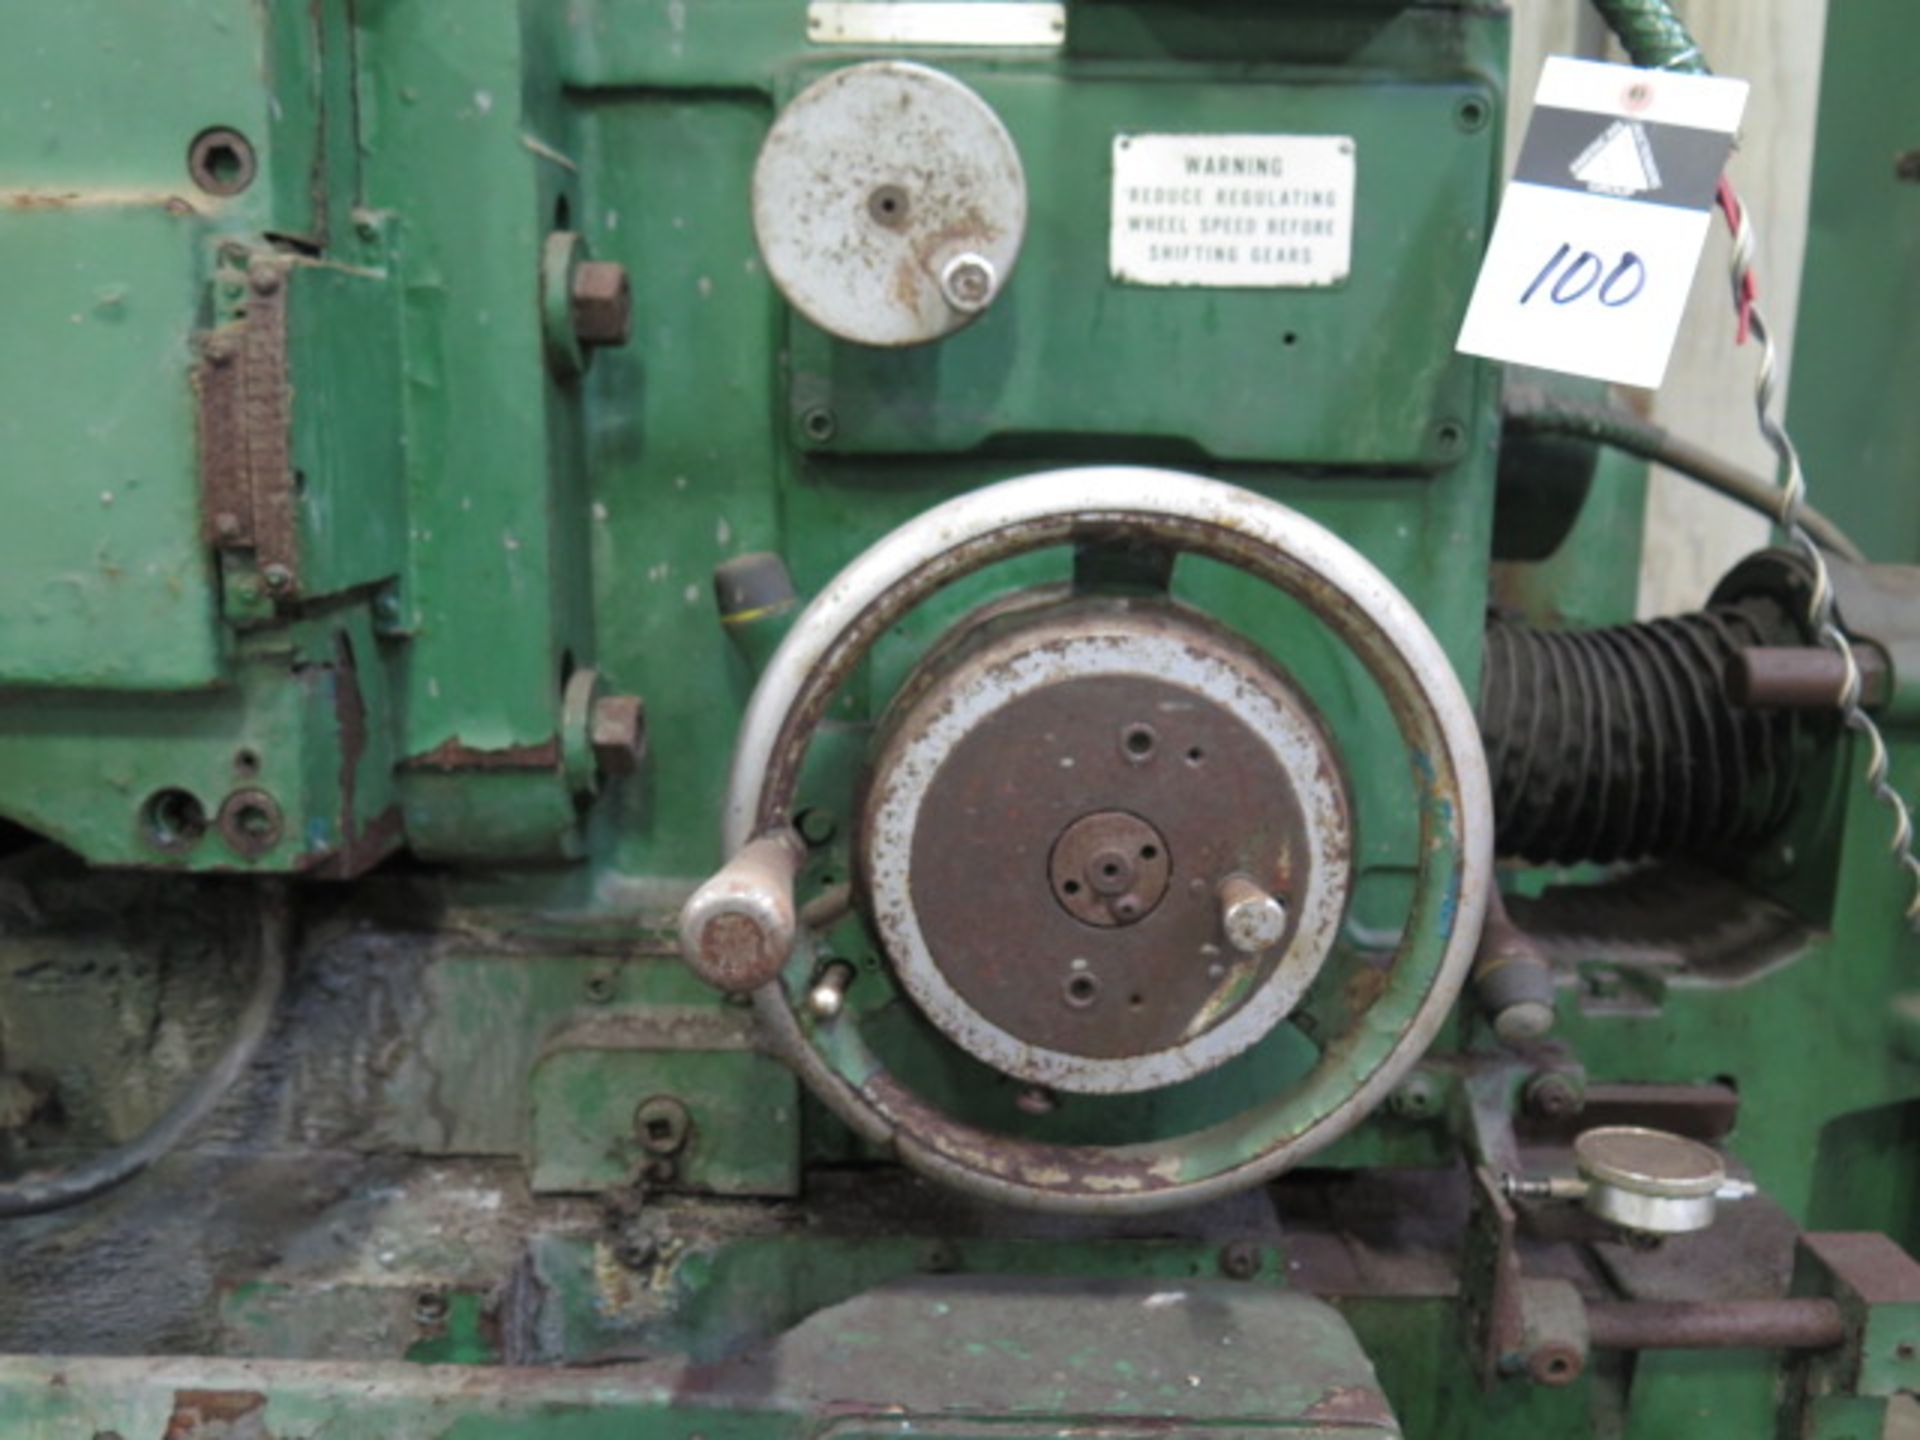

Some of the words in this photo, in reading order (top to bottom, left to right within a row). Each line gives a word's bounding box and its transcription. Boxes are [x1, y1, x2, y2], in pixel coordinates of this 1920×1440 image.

[1184, 155, 1283, 177] WARNING
[1129, 187, 1202, 206] REDUCE
[1217, 188, 1336, 208] REGULATING
[1128, 216, 1187, 234] WHEEL
[1200, 217, 1256, 235] SPEED
[1268, 218, 1335, 236] BEFORE
[1149, 244, 1238, 263] SHIFTING
[1251, 246, 1312, 264] GEARS
[1520, 243, 1645, 306] 100
